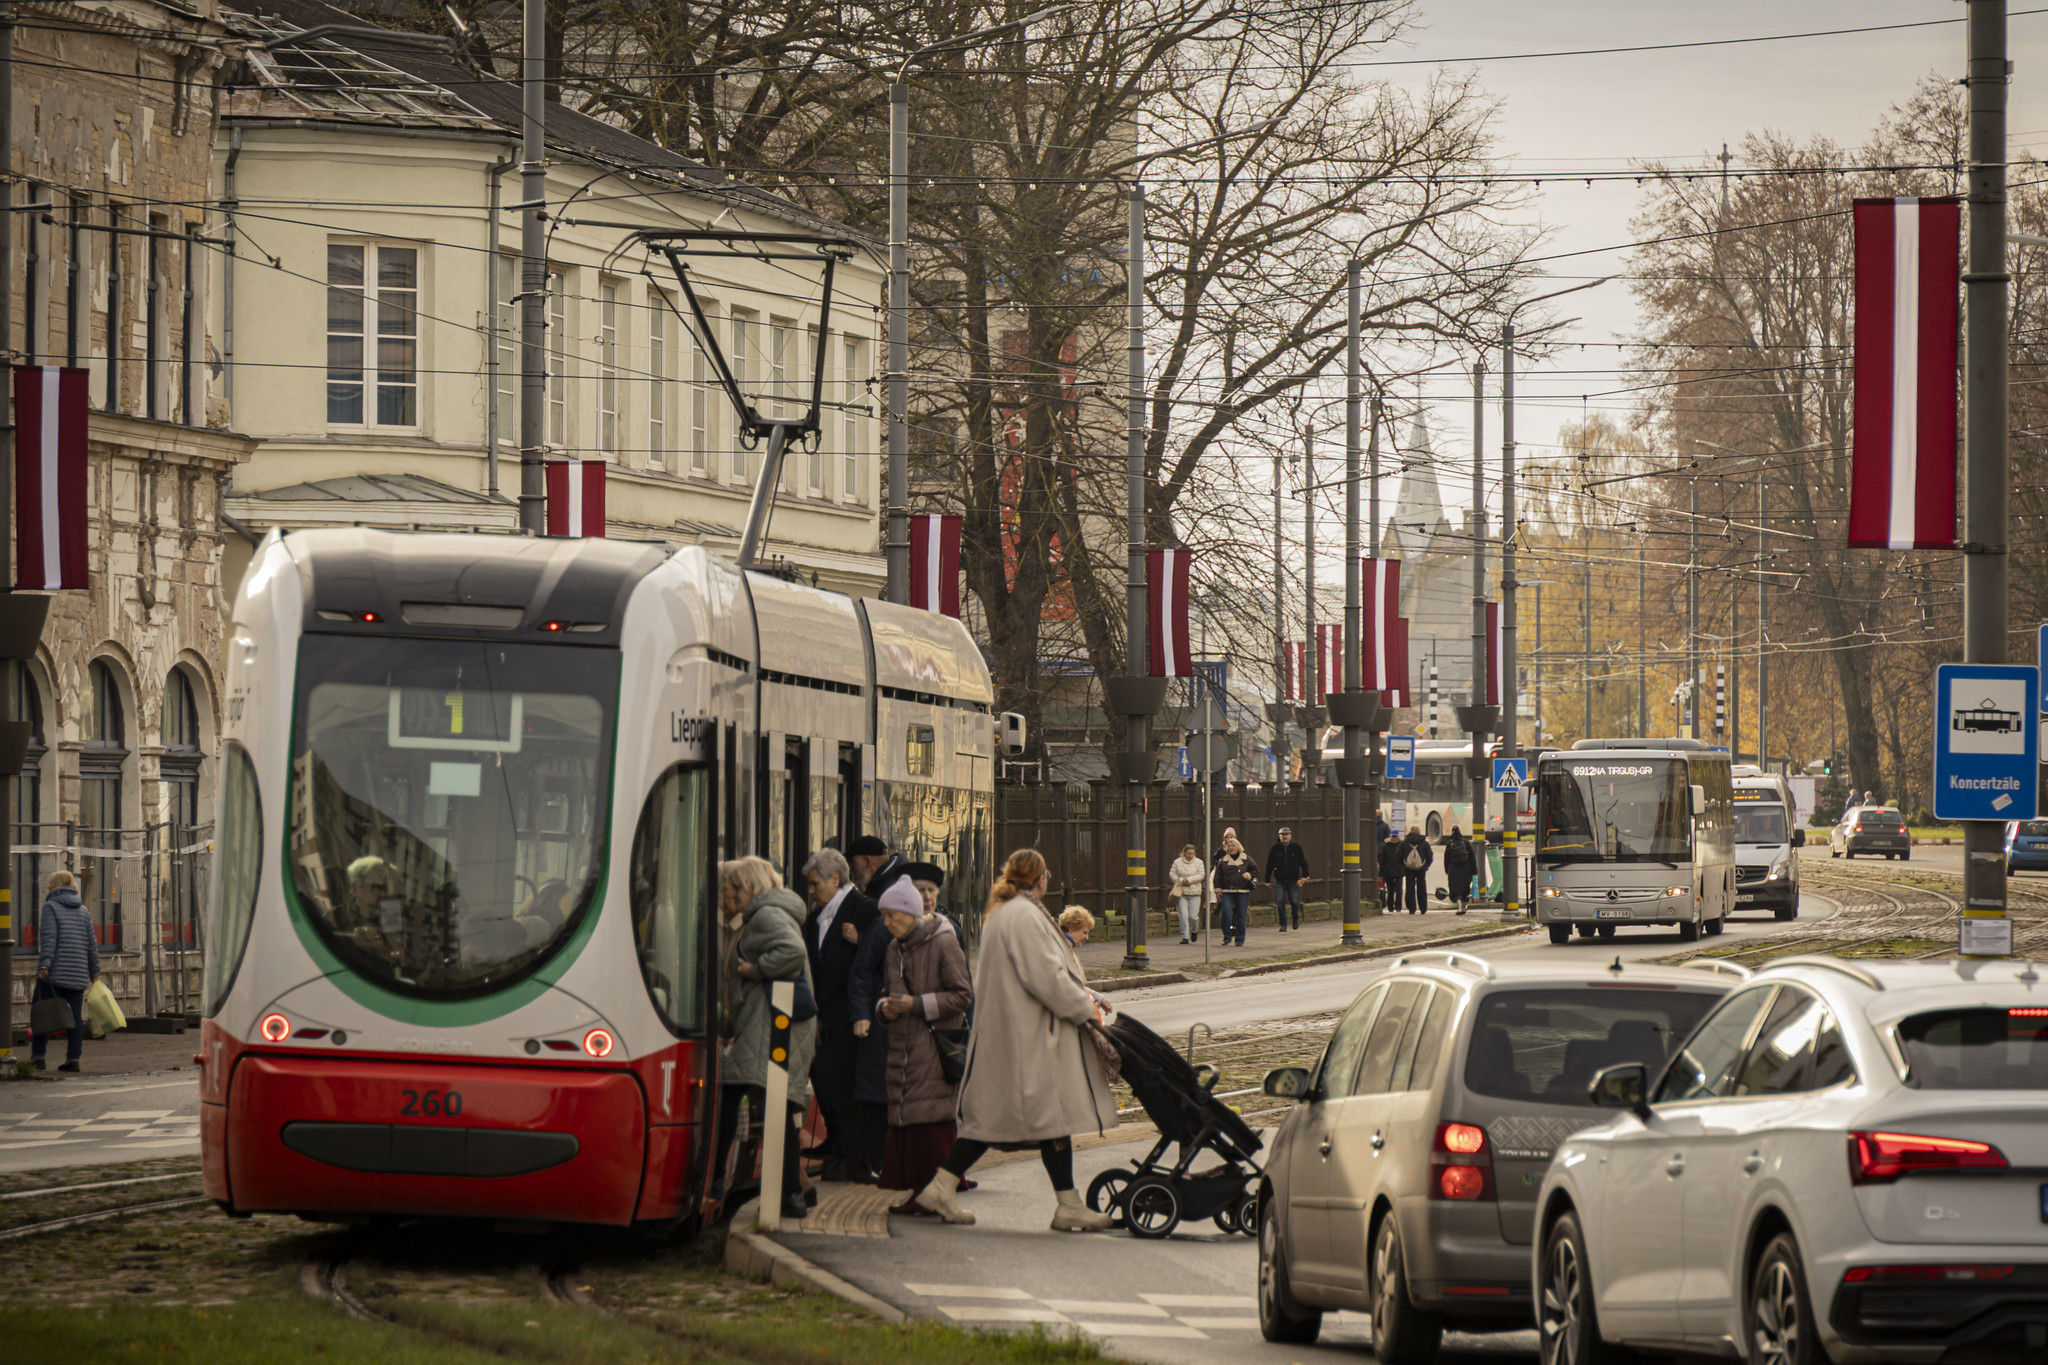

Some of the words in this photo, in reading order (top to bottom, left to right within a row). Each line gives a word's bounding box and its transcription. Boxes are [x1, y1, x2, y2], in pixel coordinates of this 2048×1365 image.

[444, 691, 463, 733] 1
[1950, 775, 2020, 790] Koncertzāle
[400, 1089, 463, 1117] 260
[1499, 1149, 1549, 1158] TOURAN
